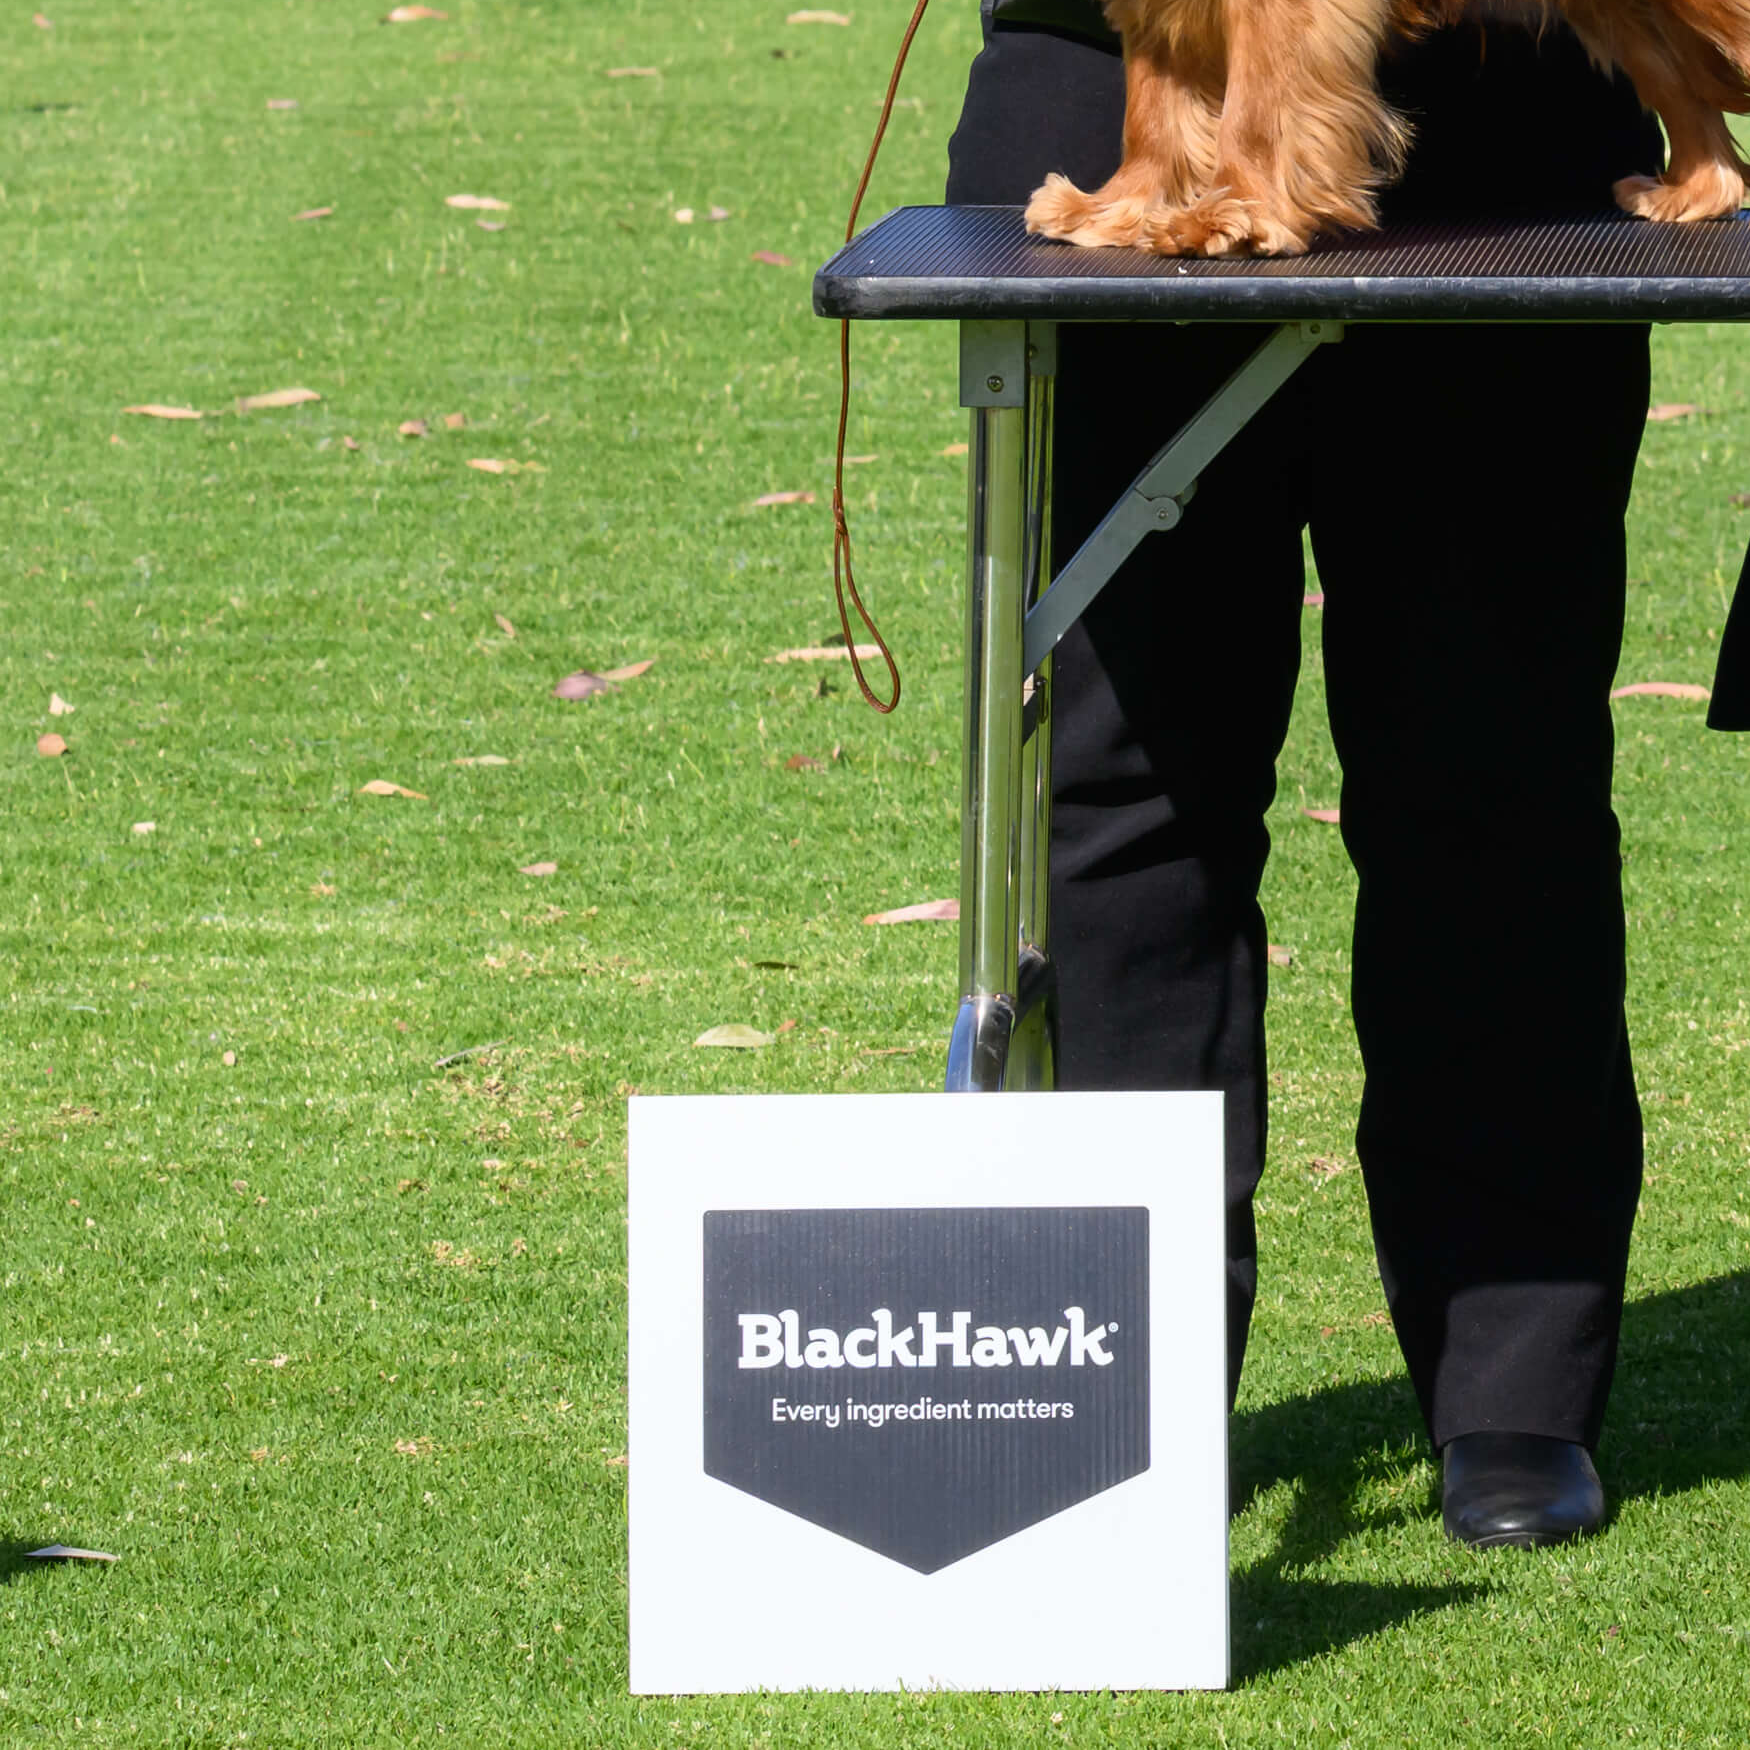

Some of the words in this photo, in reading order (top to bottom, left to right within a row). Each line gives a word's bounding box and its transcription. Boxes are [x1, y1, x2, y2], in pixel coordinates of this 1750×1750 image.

[772, 1398, 840, 1427] Every
[846, 1397, 972, 1427] ingredient
[977, 1399, 1074, 1420] matters
